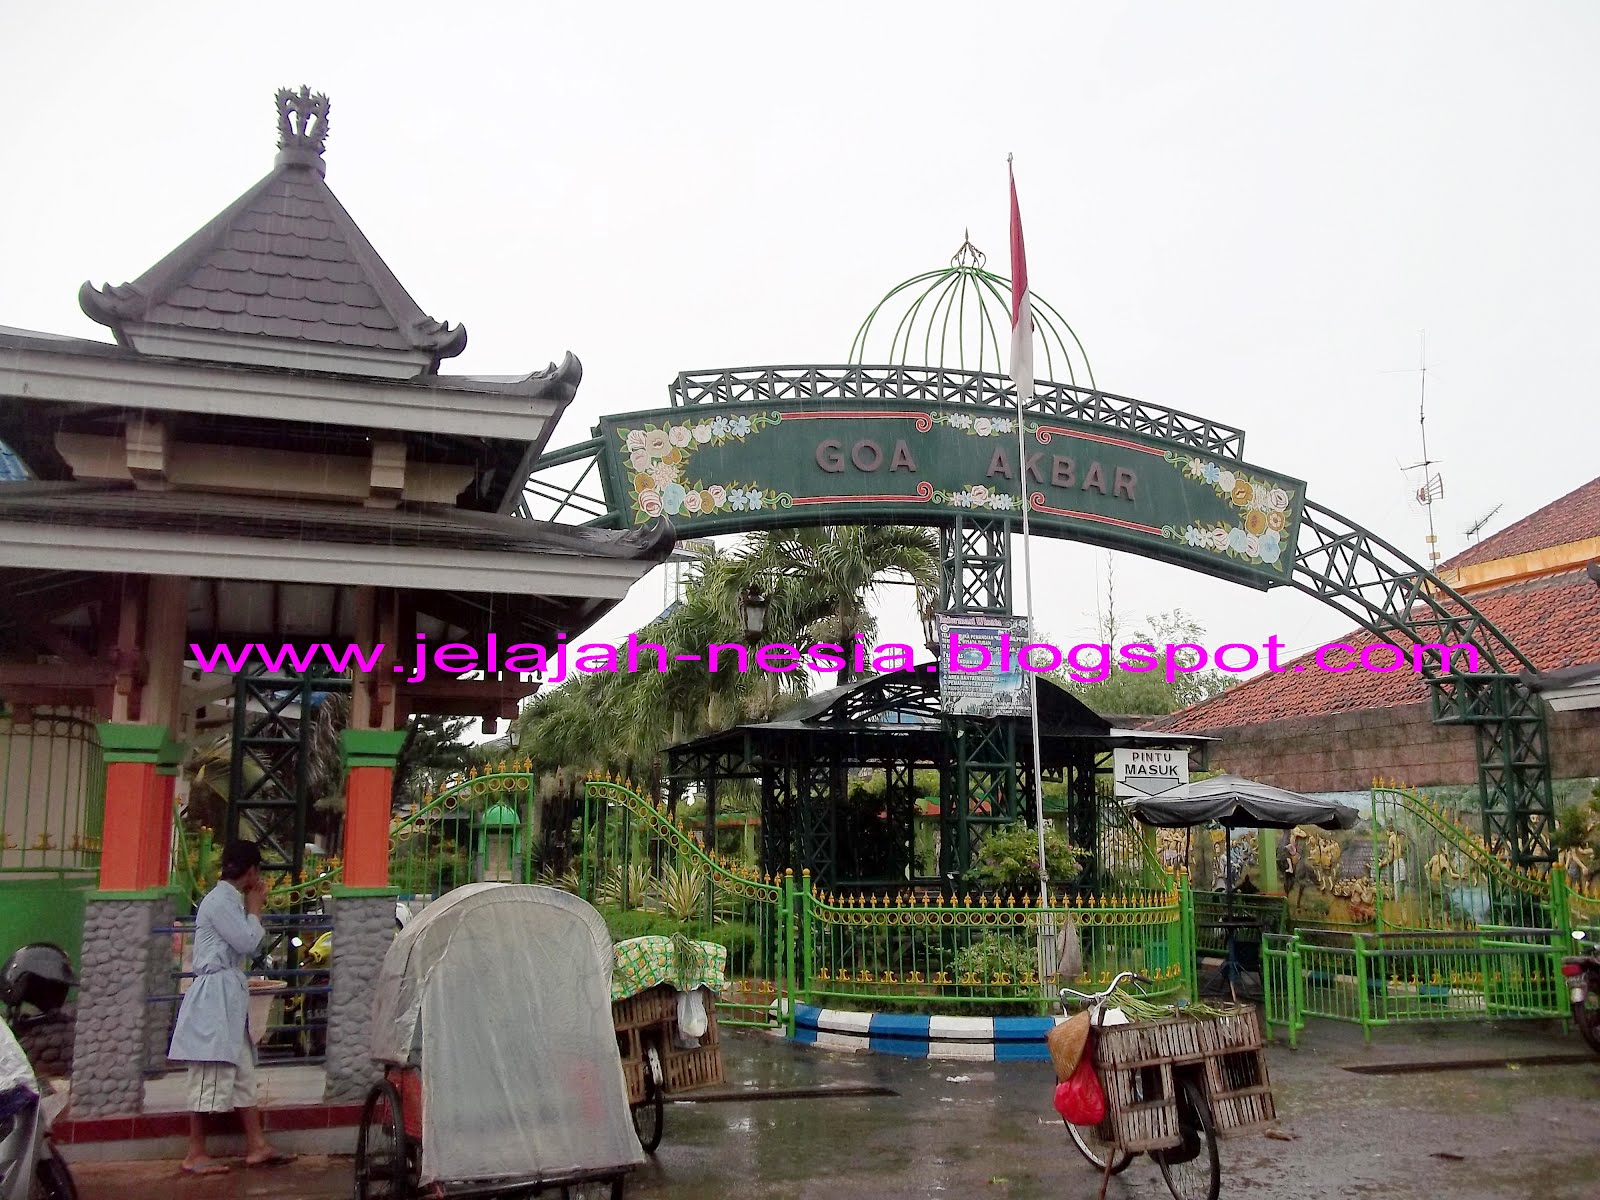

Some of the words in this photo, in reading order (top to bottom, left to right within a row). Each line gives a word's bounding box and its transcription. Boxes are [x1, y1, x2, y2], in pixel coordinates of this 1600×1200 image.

[815, 439, 918, 473] GOA
[986, 447, 1138, 501] AKBAR
[1132, 752, 1171, 762] PINTU
[1125, 764, 1178, 776] MASUK
